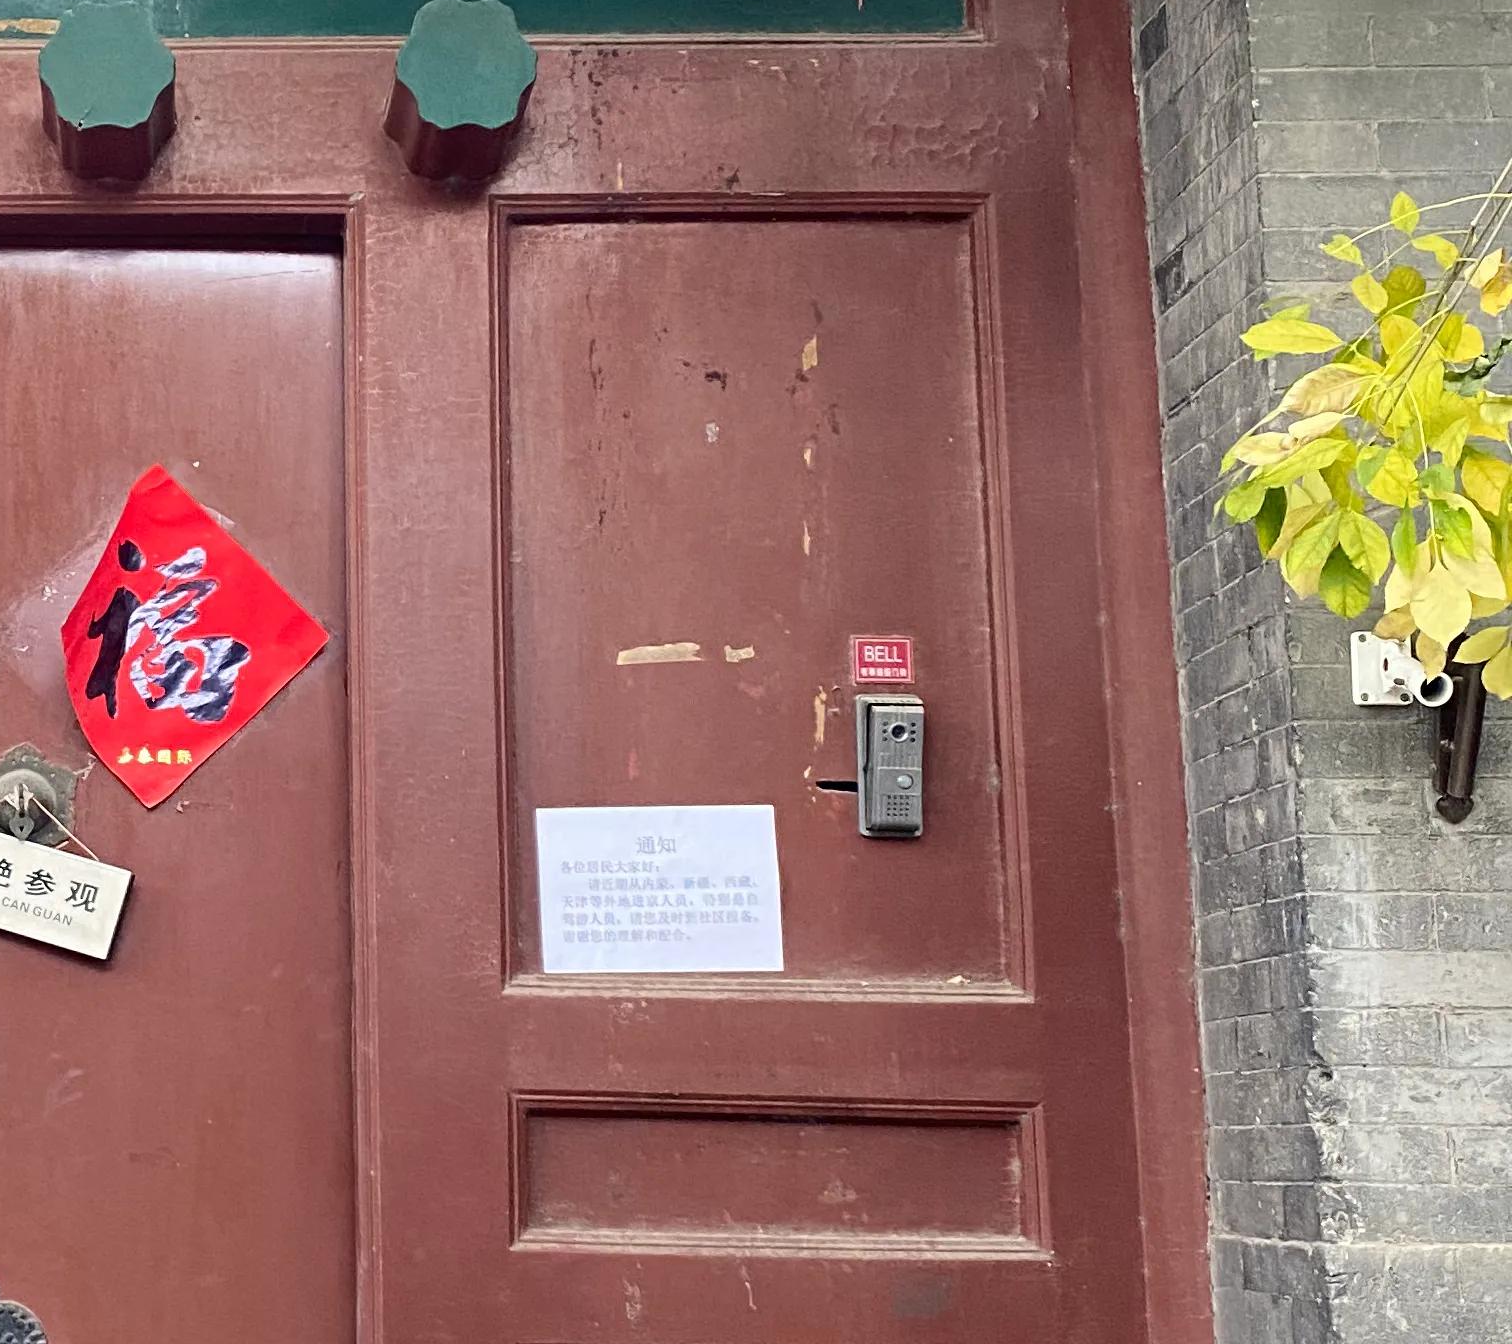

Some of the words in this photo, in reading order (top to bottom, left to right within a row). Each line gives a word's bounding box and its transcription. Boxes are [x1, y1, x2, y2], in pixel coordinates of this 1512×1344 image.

[86, 538, 252, 723] 福
[864, 646, 903, 663] BELL
[636, 836, 677, 854] 通知
[2, 897, 29, 914] CAN
[33, 906, 72, 927] GUAN
